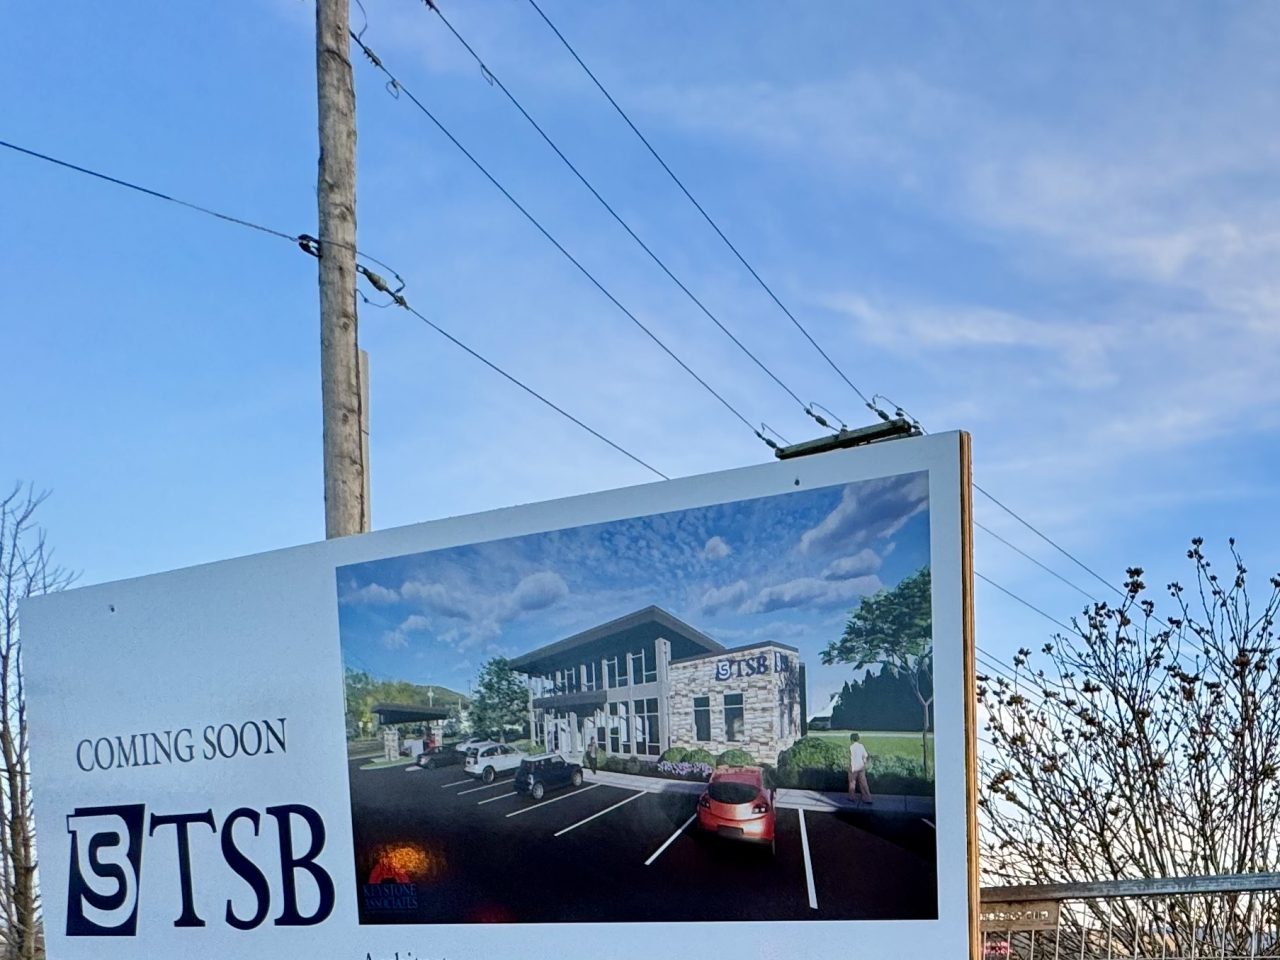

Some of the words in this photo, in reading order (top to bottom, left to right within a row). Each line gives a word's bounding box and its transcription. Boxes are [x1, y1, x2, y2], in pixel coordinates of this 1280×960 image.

[731, 655, 768, 678] TSB
[76, 728, 195, 772] COMING
[202, 717, 287, 761] SOON
[148, 803, 335, 930] TSB
